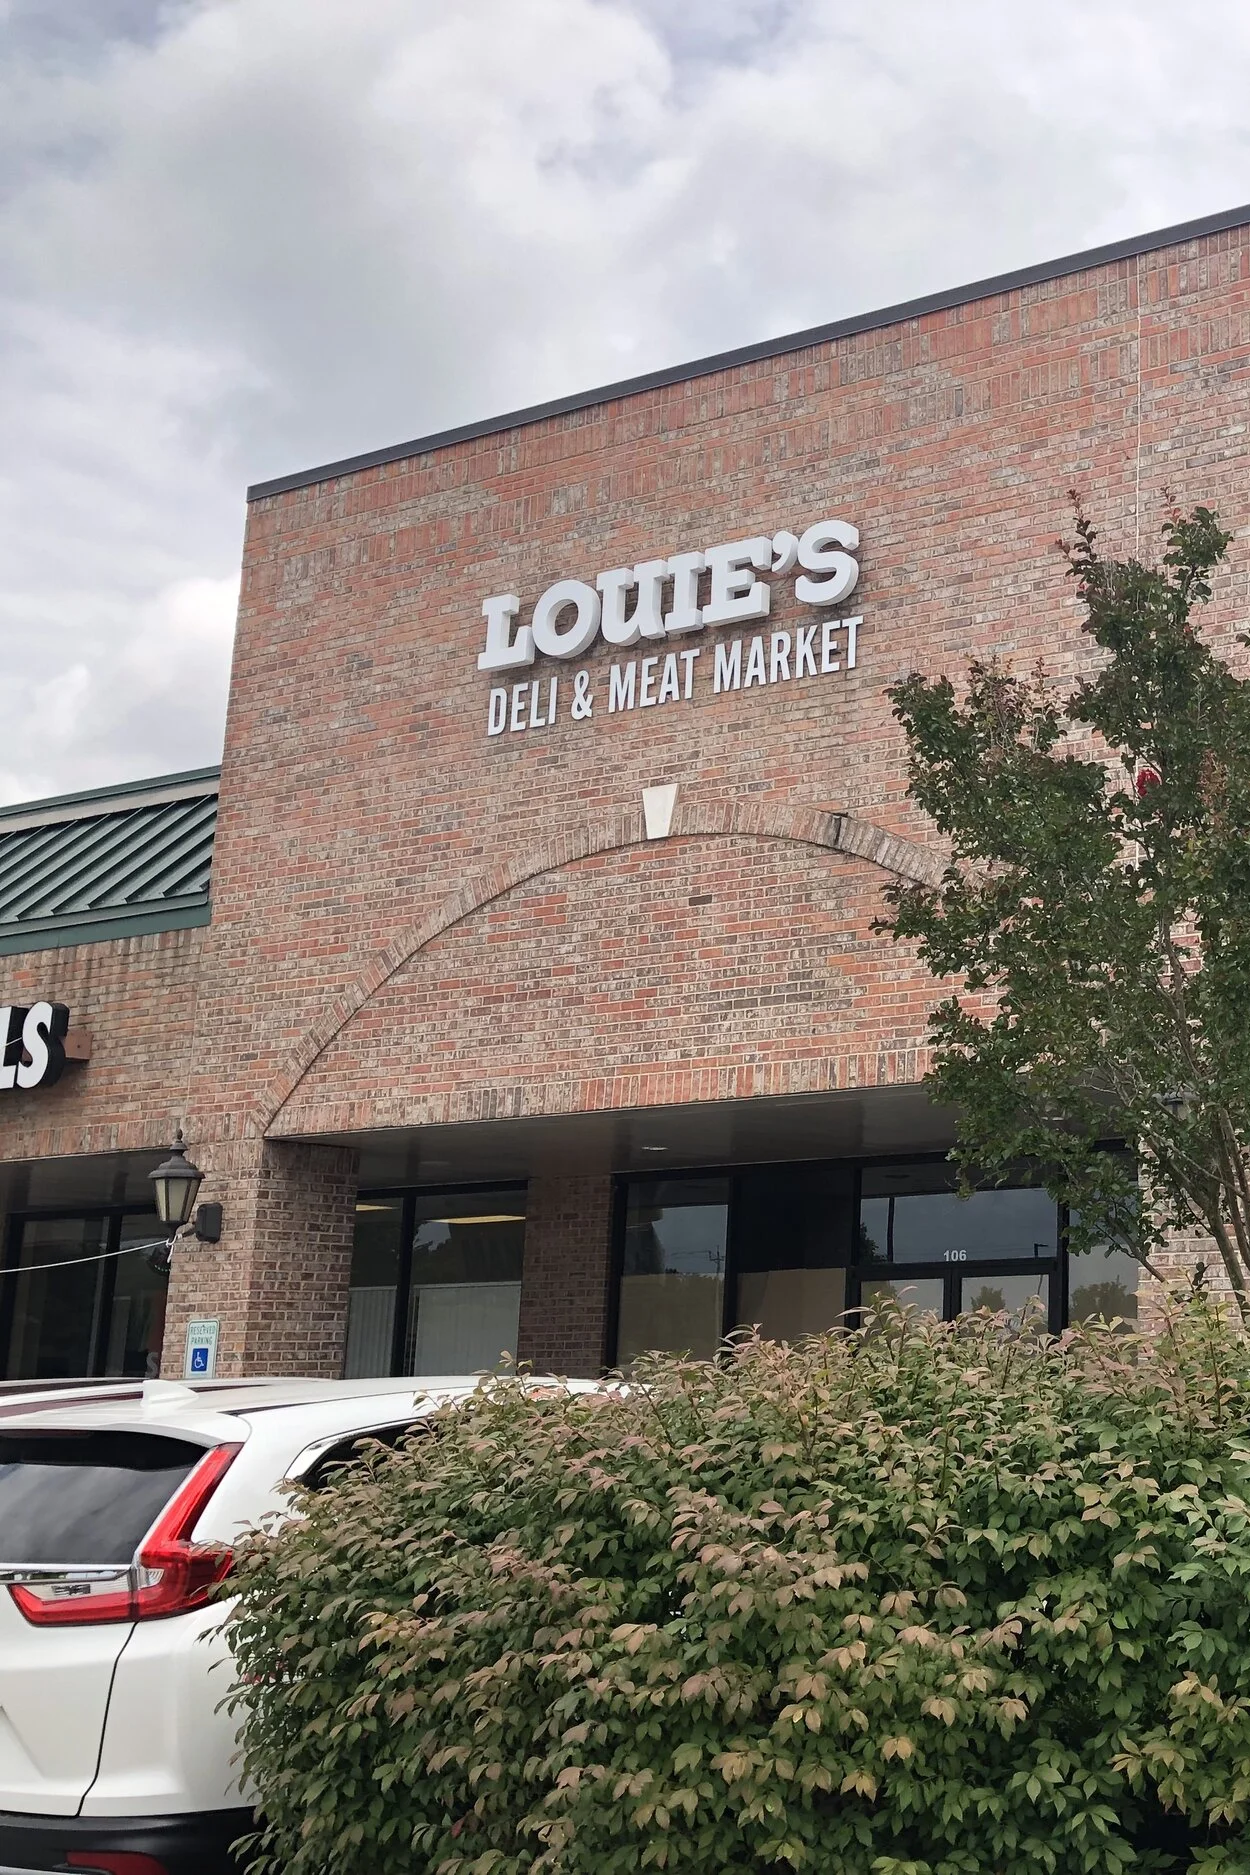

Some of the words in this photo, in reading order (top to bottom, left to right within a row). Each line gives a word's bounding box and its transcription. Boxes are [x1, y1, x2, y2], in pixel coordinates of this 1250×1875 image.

[478, 519, 860, 671] LOUIE'S
[488, 676, 558, 736] DELI
[571, 670, 594, 720] &
[608, 649, 700, 713] MEAT
[713, 616, 864, 694] MARKET
[943, 1249, 967, 1262] 106
[190, 1325, 216, 1335] RESERVED
[191, 1336, 213, 1346] PARKING
